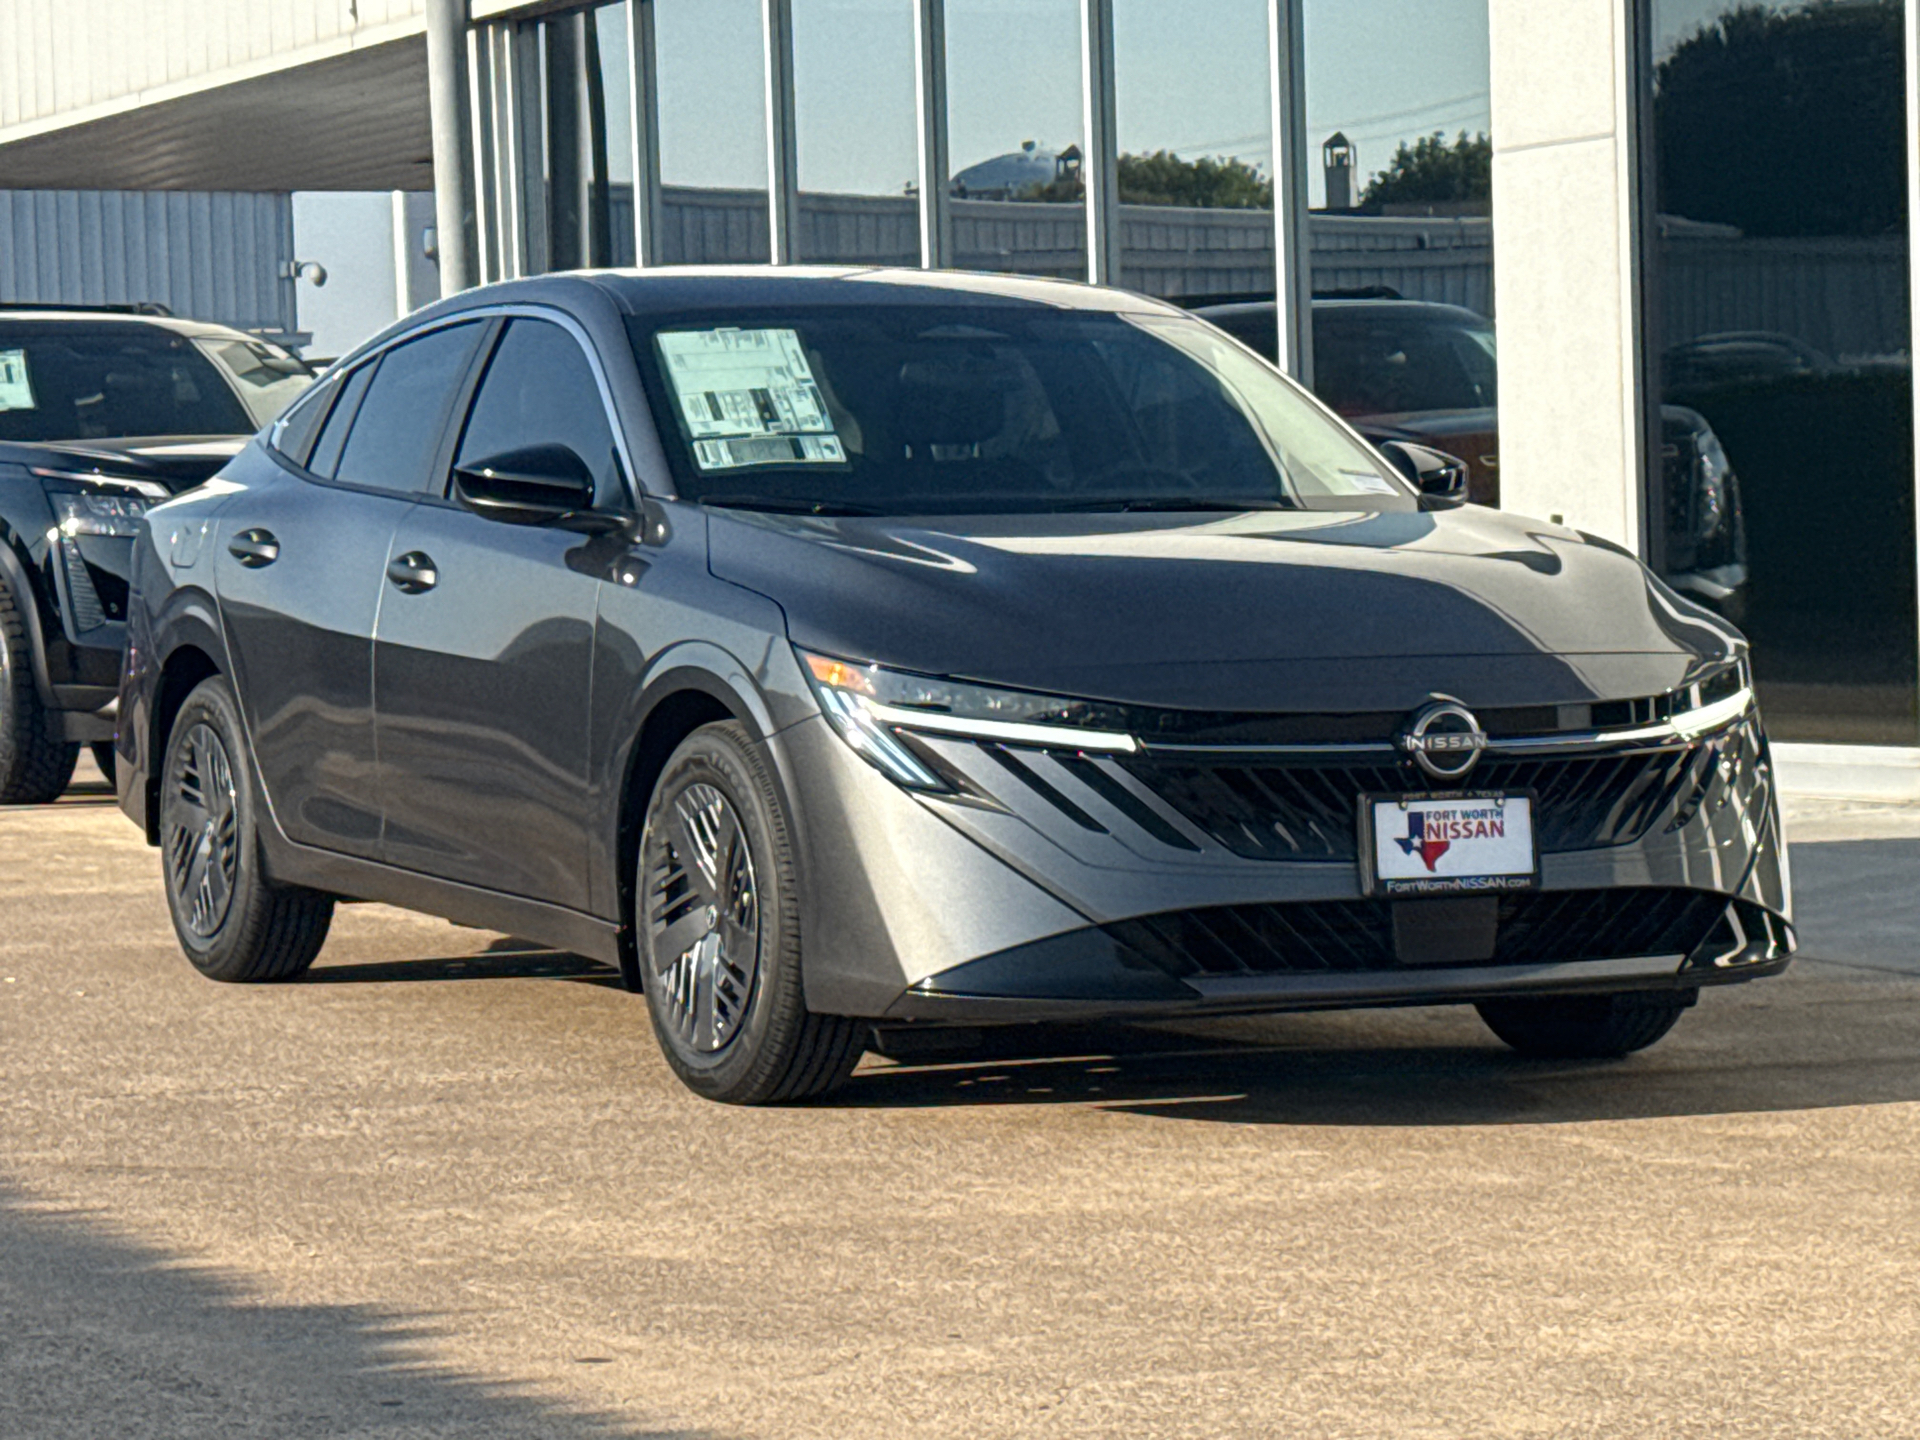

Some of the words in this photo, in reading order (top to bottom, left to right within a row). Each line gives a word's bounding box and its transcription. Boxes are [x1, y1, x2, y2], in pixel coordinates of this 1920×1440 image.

[1406, 735, 1486, 750] NISSAN
[1425, 809, 1458, 821] FORT
[1460, 808, 1504, 820] WORTH
[1426, 820, 1504, 839] NISSAN
